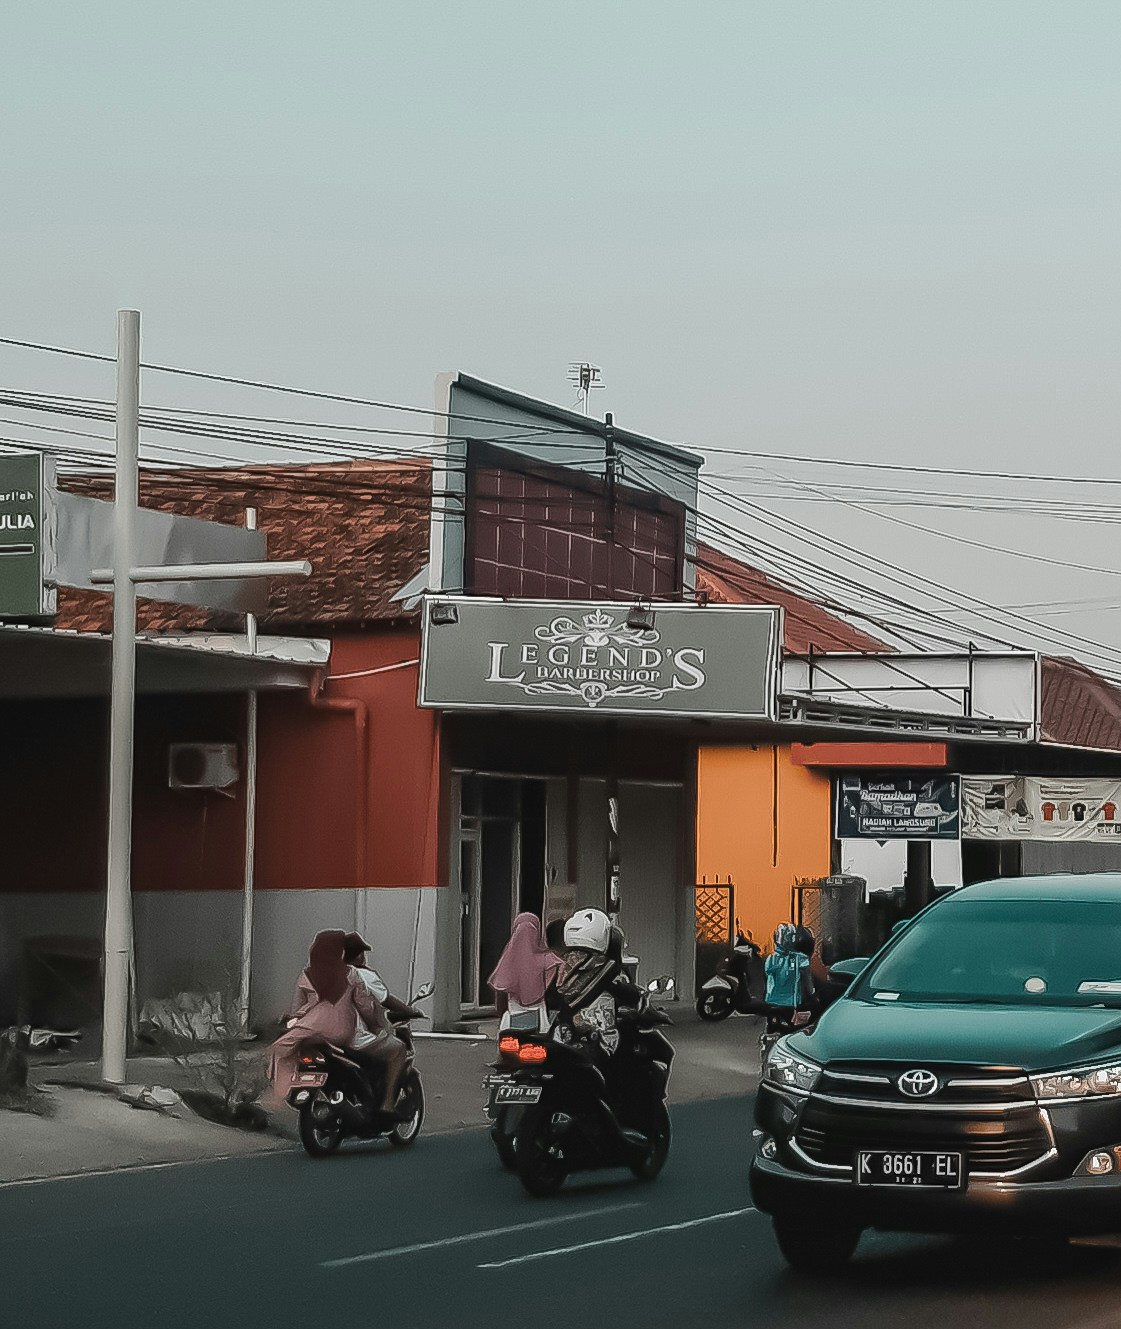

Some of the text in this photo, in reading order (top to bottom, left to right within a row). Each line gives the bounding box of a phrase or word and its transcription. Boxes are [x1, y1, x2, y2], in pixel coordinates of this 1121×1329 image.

[485, 642, 706, 690] LEGEND'S
[536, 665, 661, 682] BARBERSHOP
[861, 1153, 872, 1173] K
[935, 1155, 957, 1176] EL
